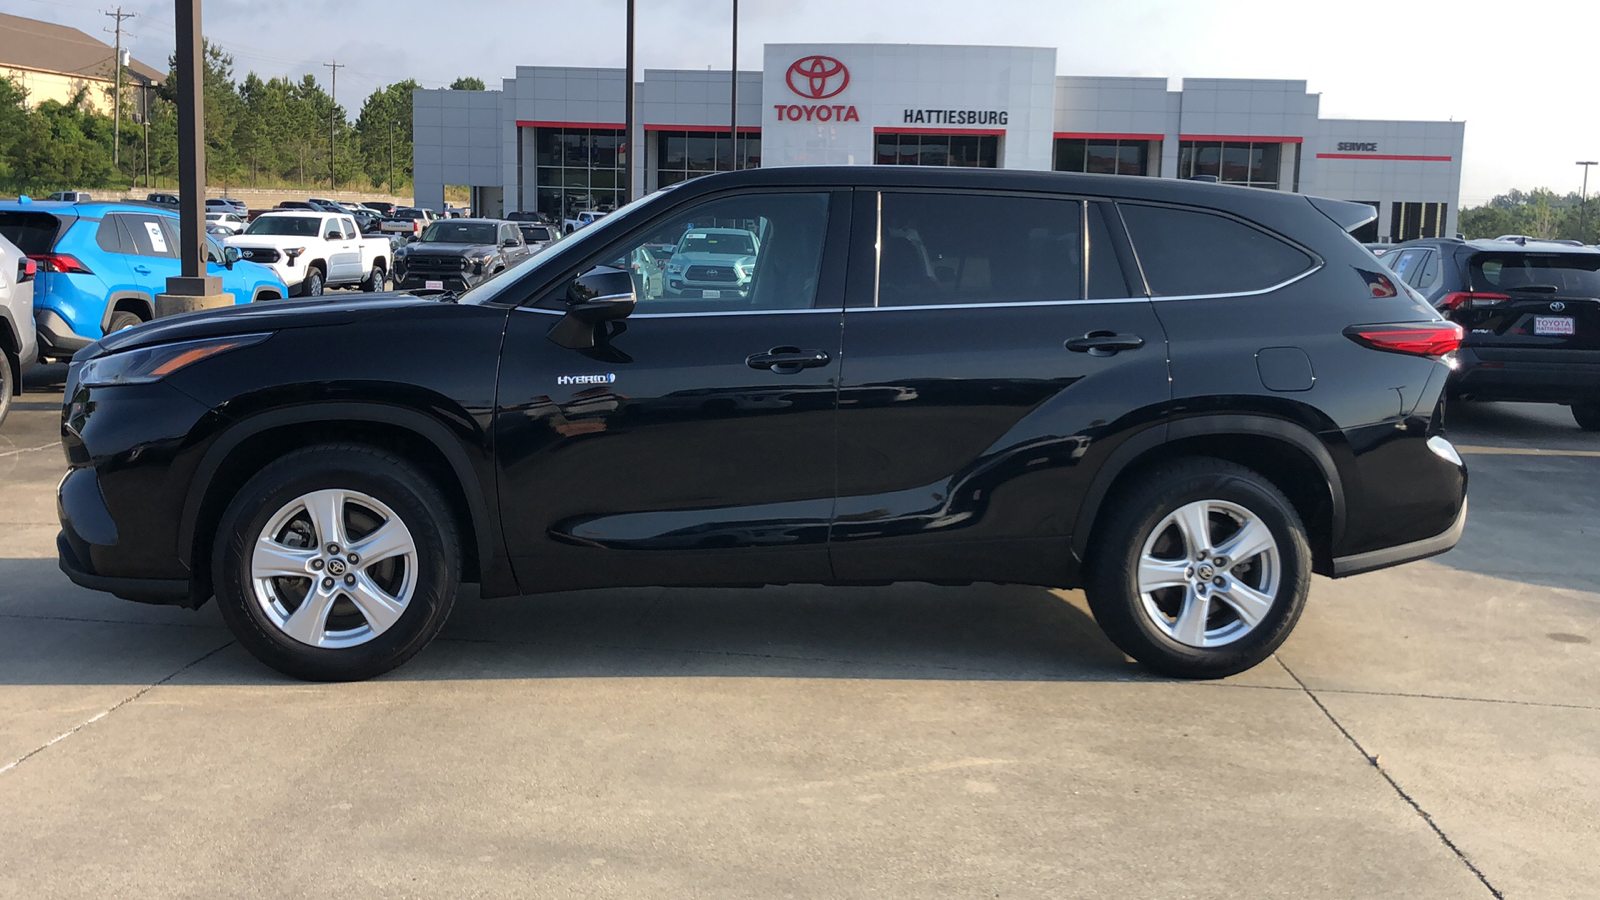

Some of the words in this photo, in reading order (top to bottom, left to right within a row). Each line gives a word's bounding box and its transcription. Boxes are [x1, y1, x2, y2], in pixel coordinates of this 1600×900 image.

[774, 105, 859, 122] TOYOTA
[904, 109, 1008, 125] HATTIESBURG
[1337, 142, 1377, 152] SERVICE
[557, 374, 606, 385] HYBRID
